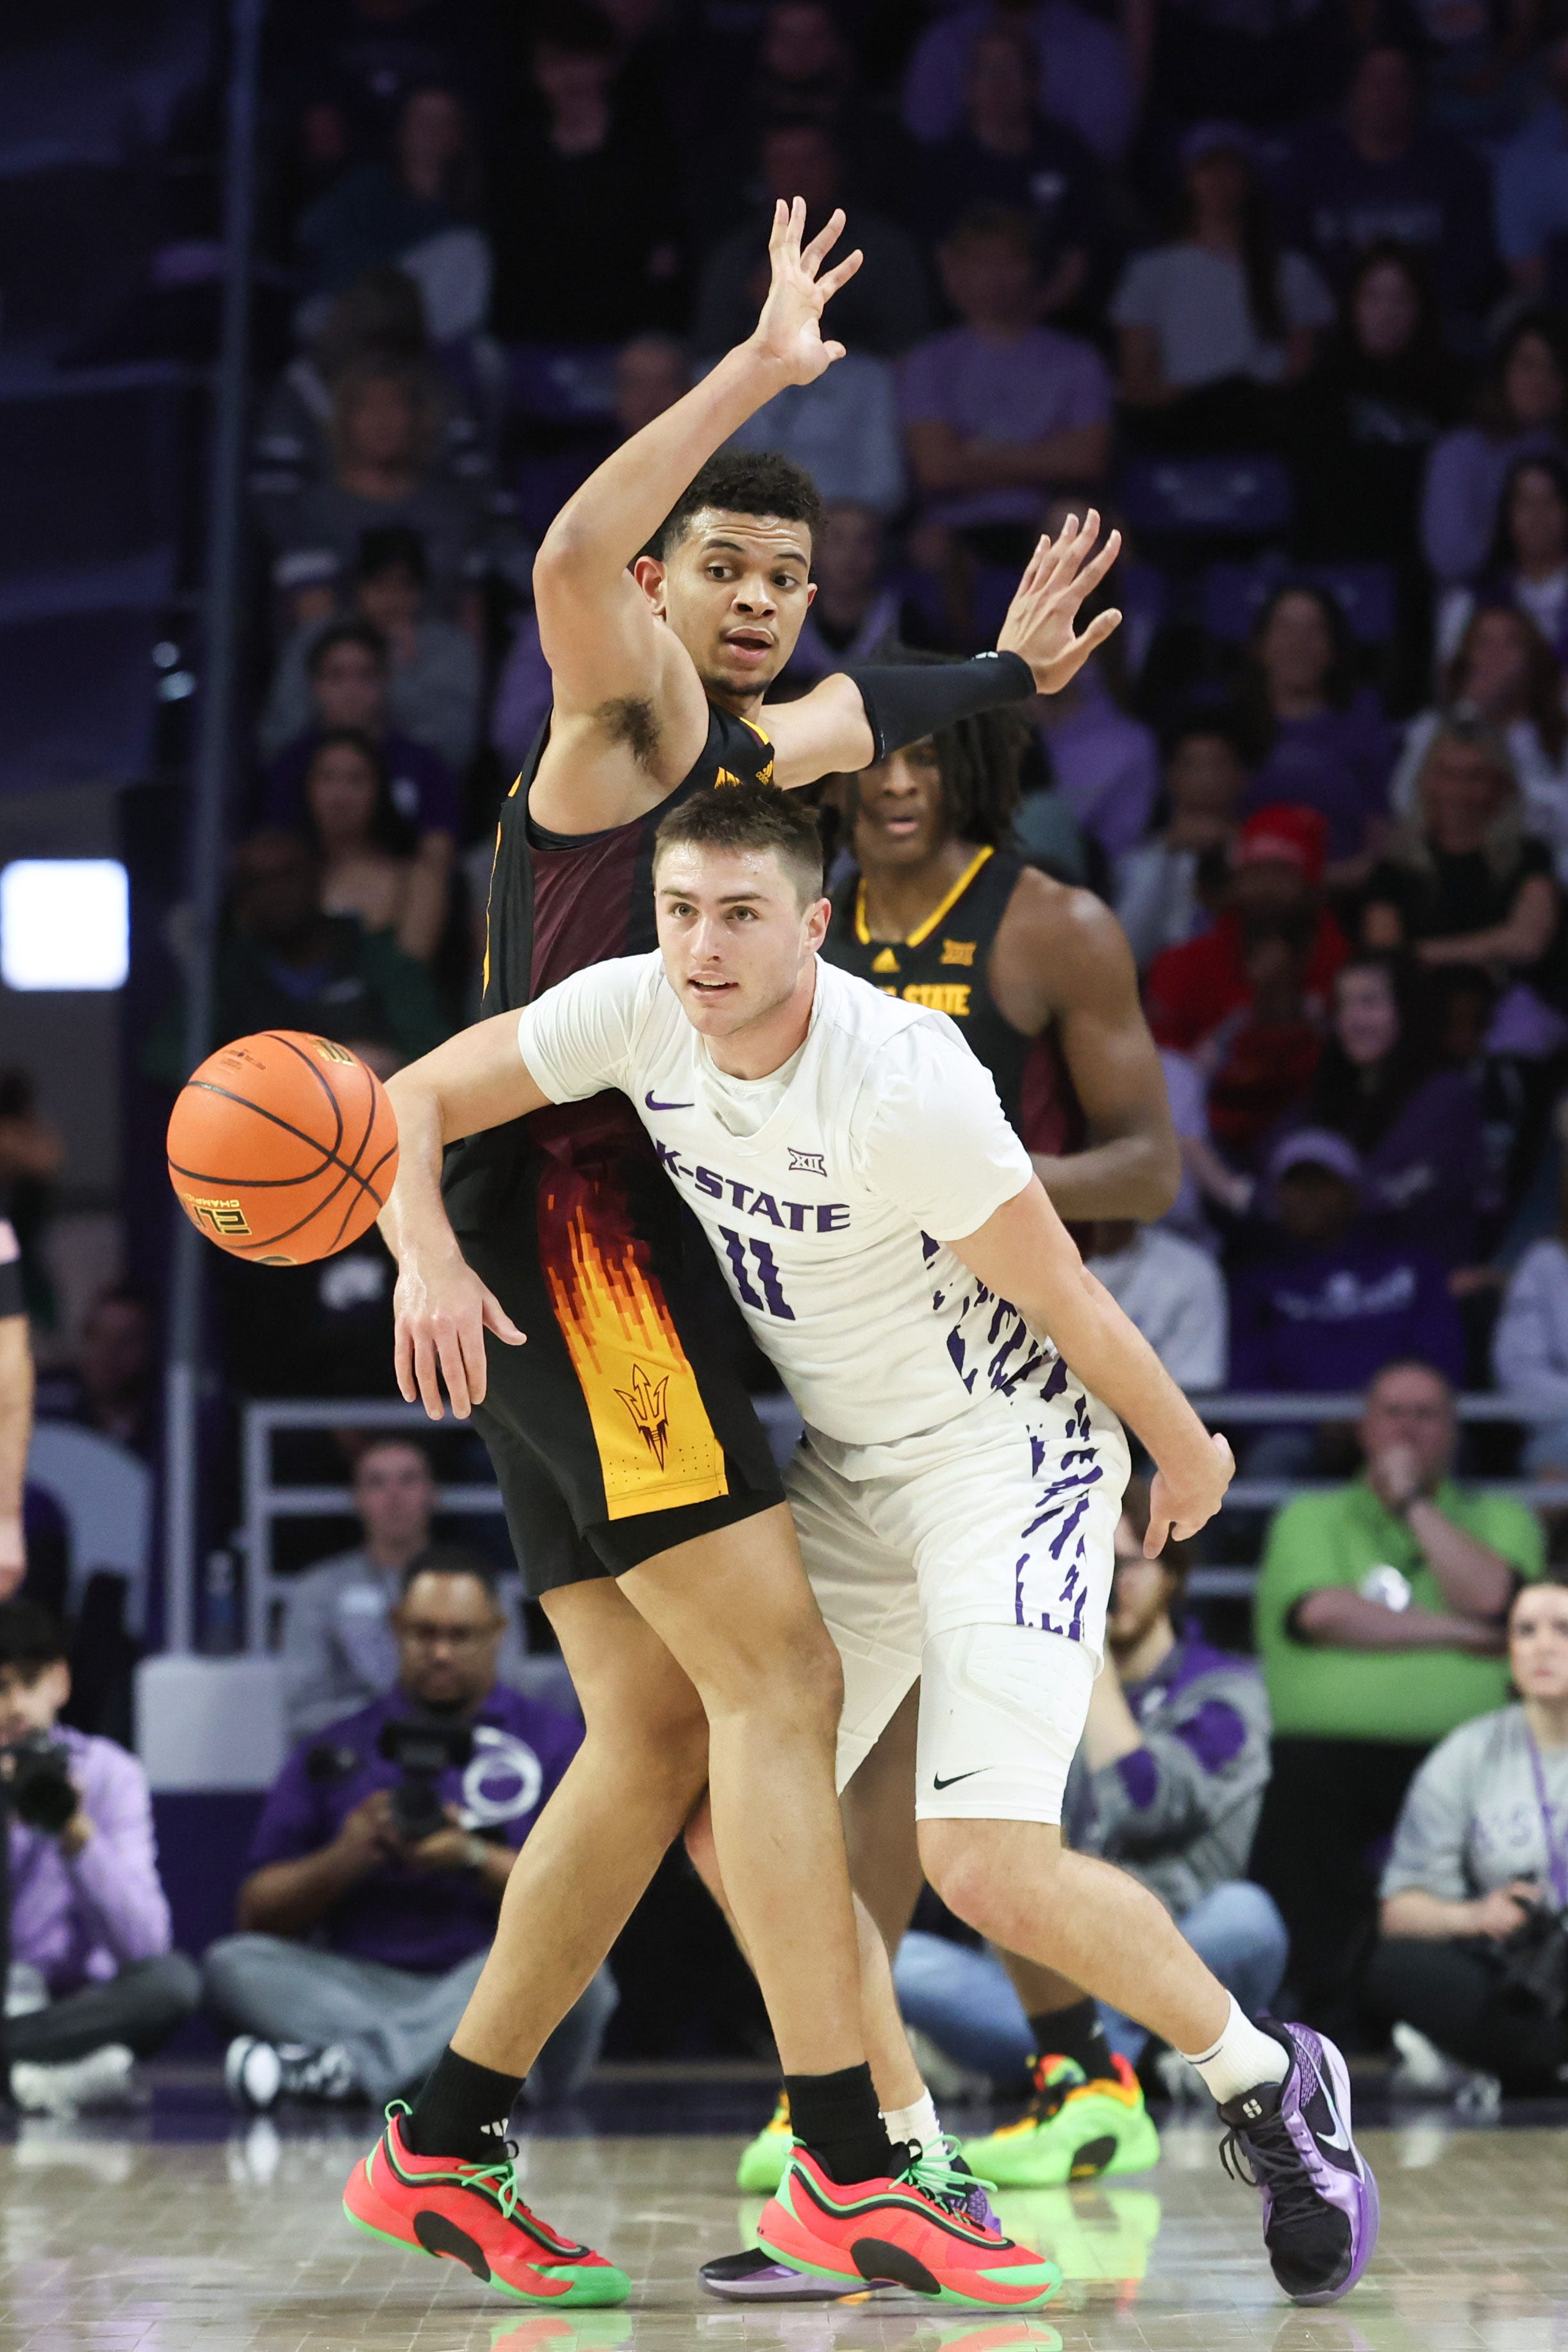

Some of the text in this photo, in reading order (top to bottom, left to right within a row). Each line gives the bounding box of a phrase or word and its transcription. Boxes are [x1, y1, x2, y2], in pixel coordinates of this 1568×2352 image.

[183, 1193, 240, 1208] CHAMPIO
[655, 1139, 851, 1233] K-STATE
[718, 1225, 796, 1321] 11
